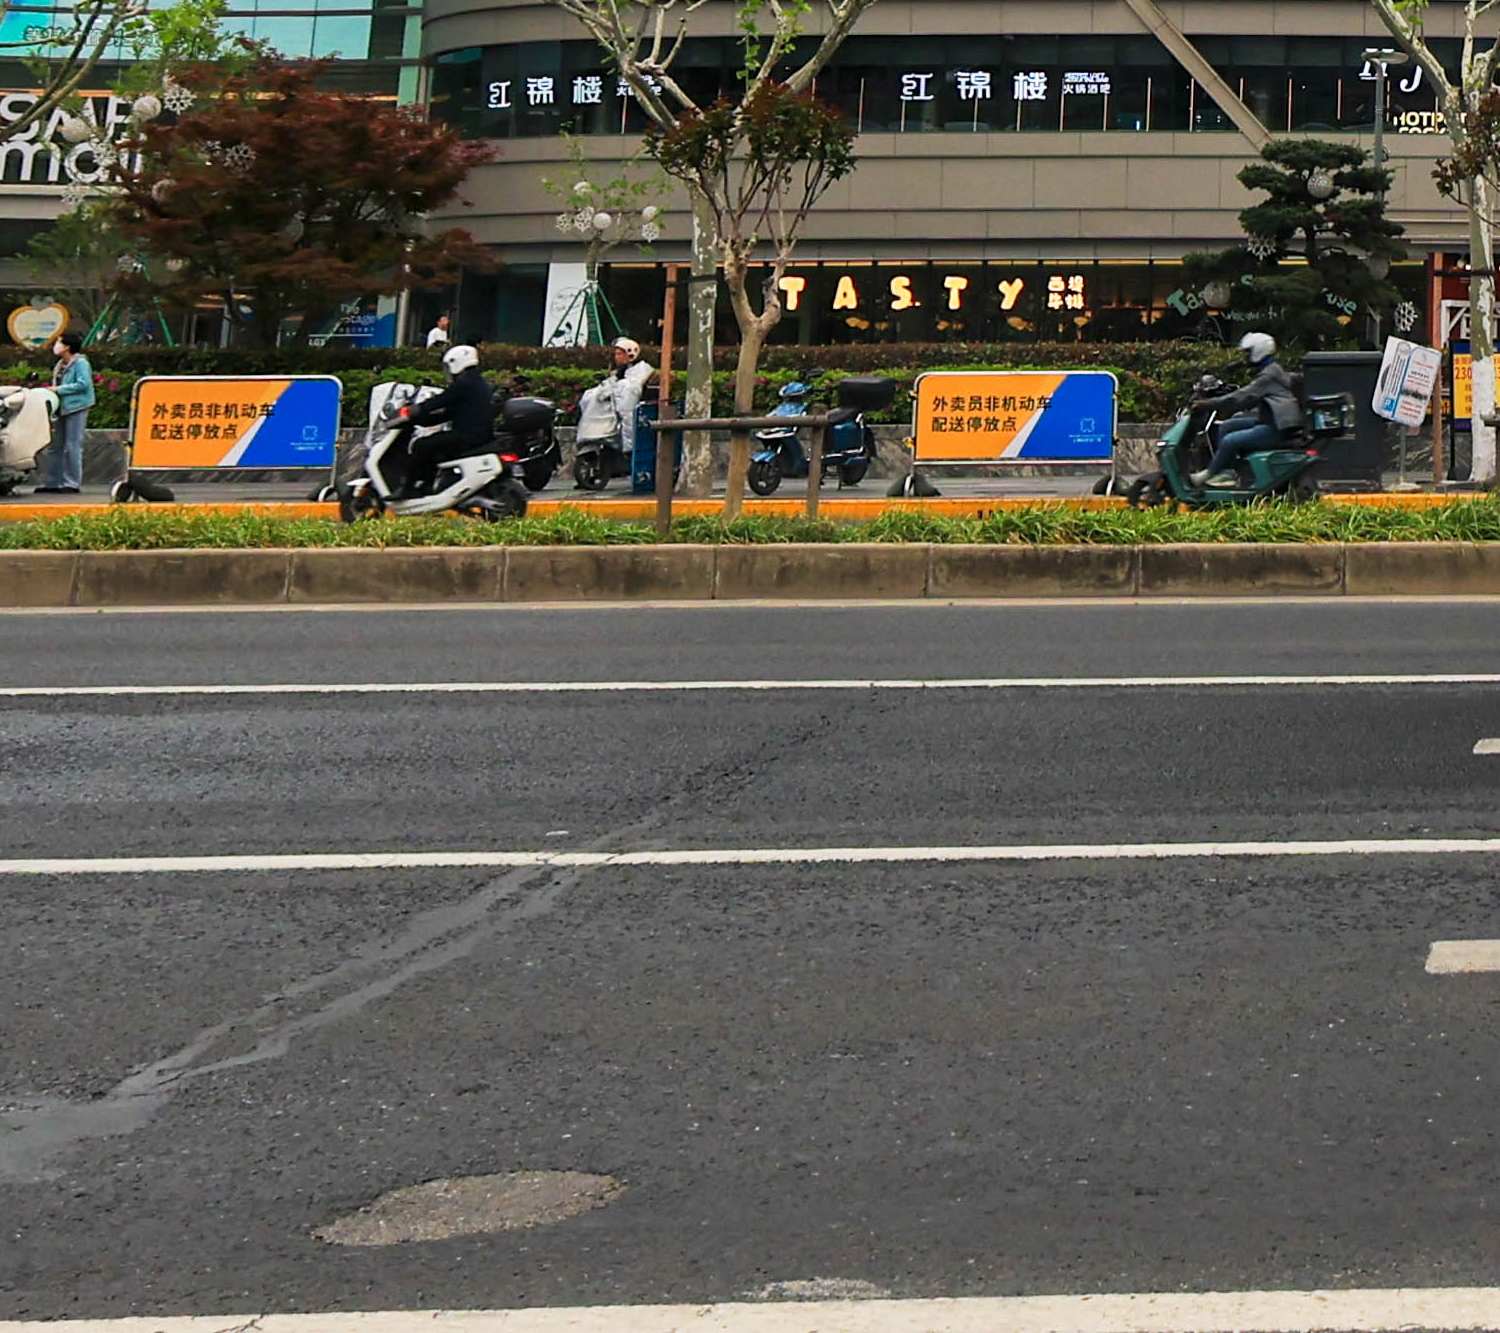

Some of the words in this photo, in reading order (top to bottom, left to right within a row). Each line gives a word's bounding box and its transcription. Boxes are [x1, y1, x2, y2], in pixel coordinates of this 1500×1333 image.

[779, 276, 1024, 310] TASTY
[152, 402, 276, 420] 外卖员非机动车
[932, 395, 1052, 412] 外卖员非机动车
[150, 423, 238, 440] 配送停放点
[931, 416, 1017, 432] 配送停放点
